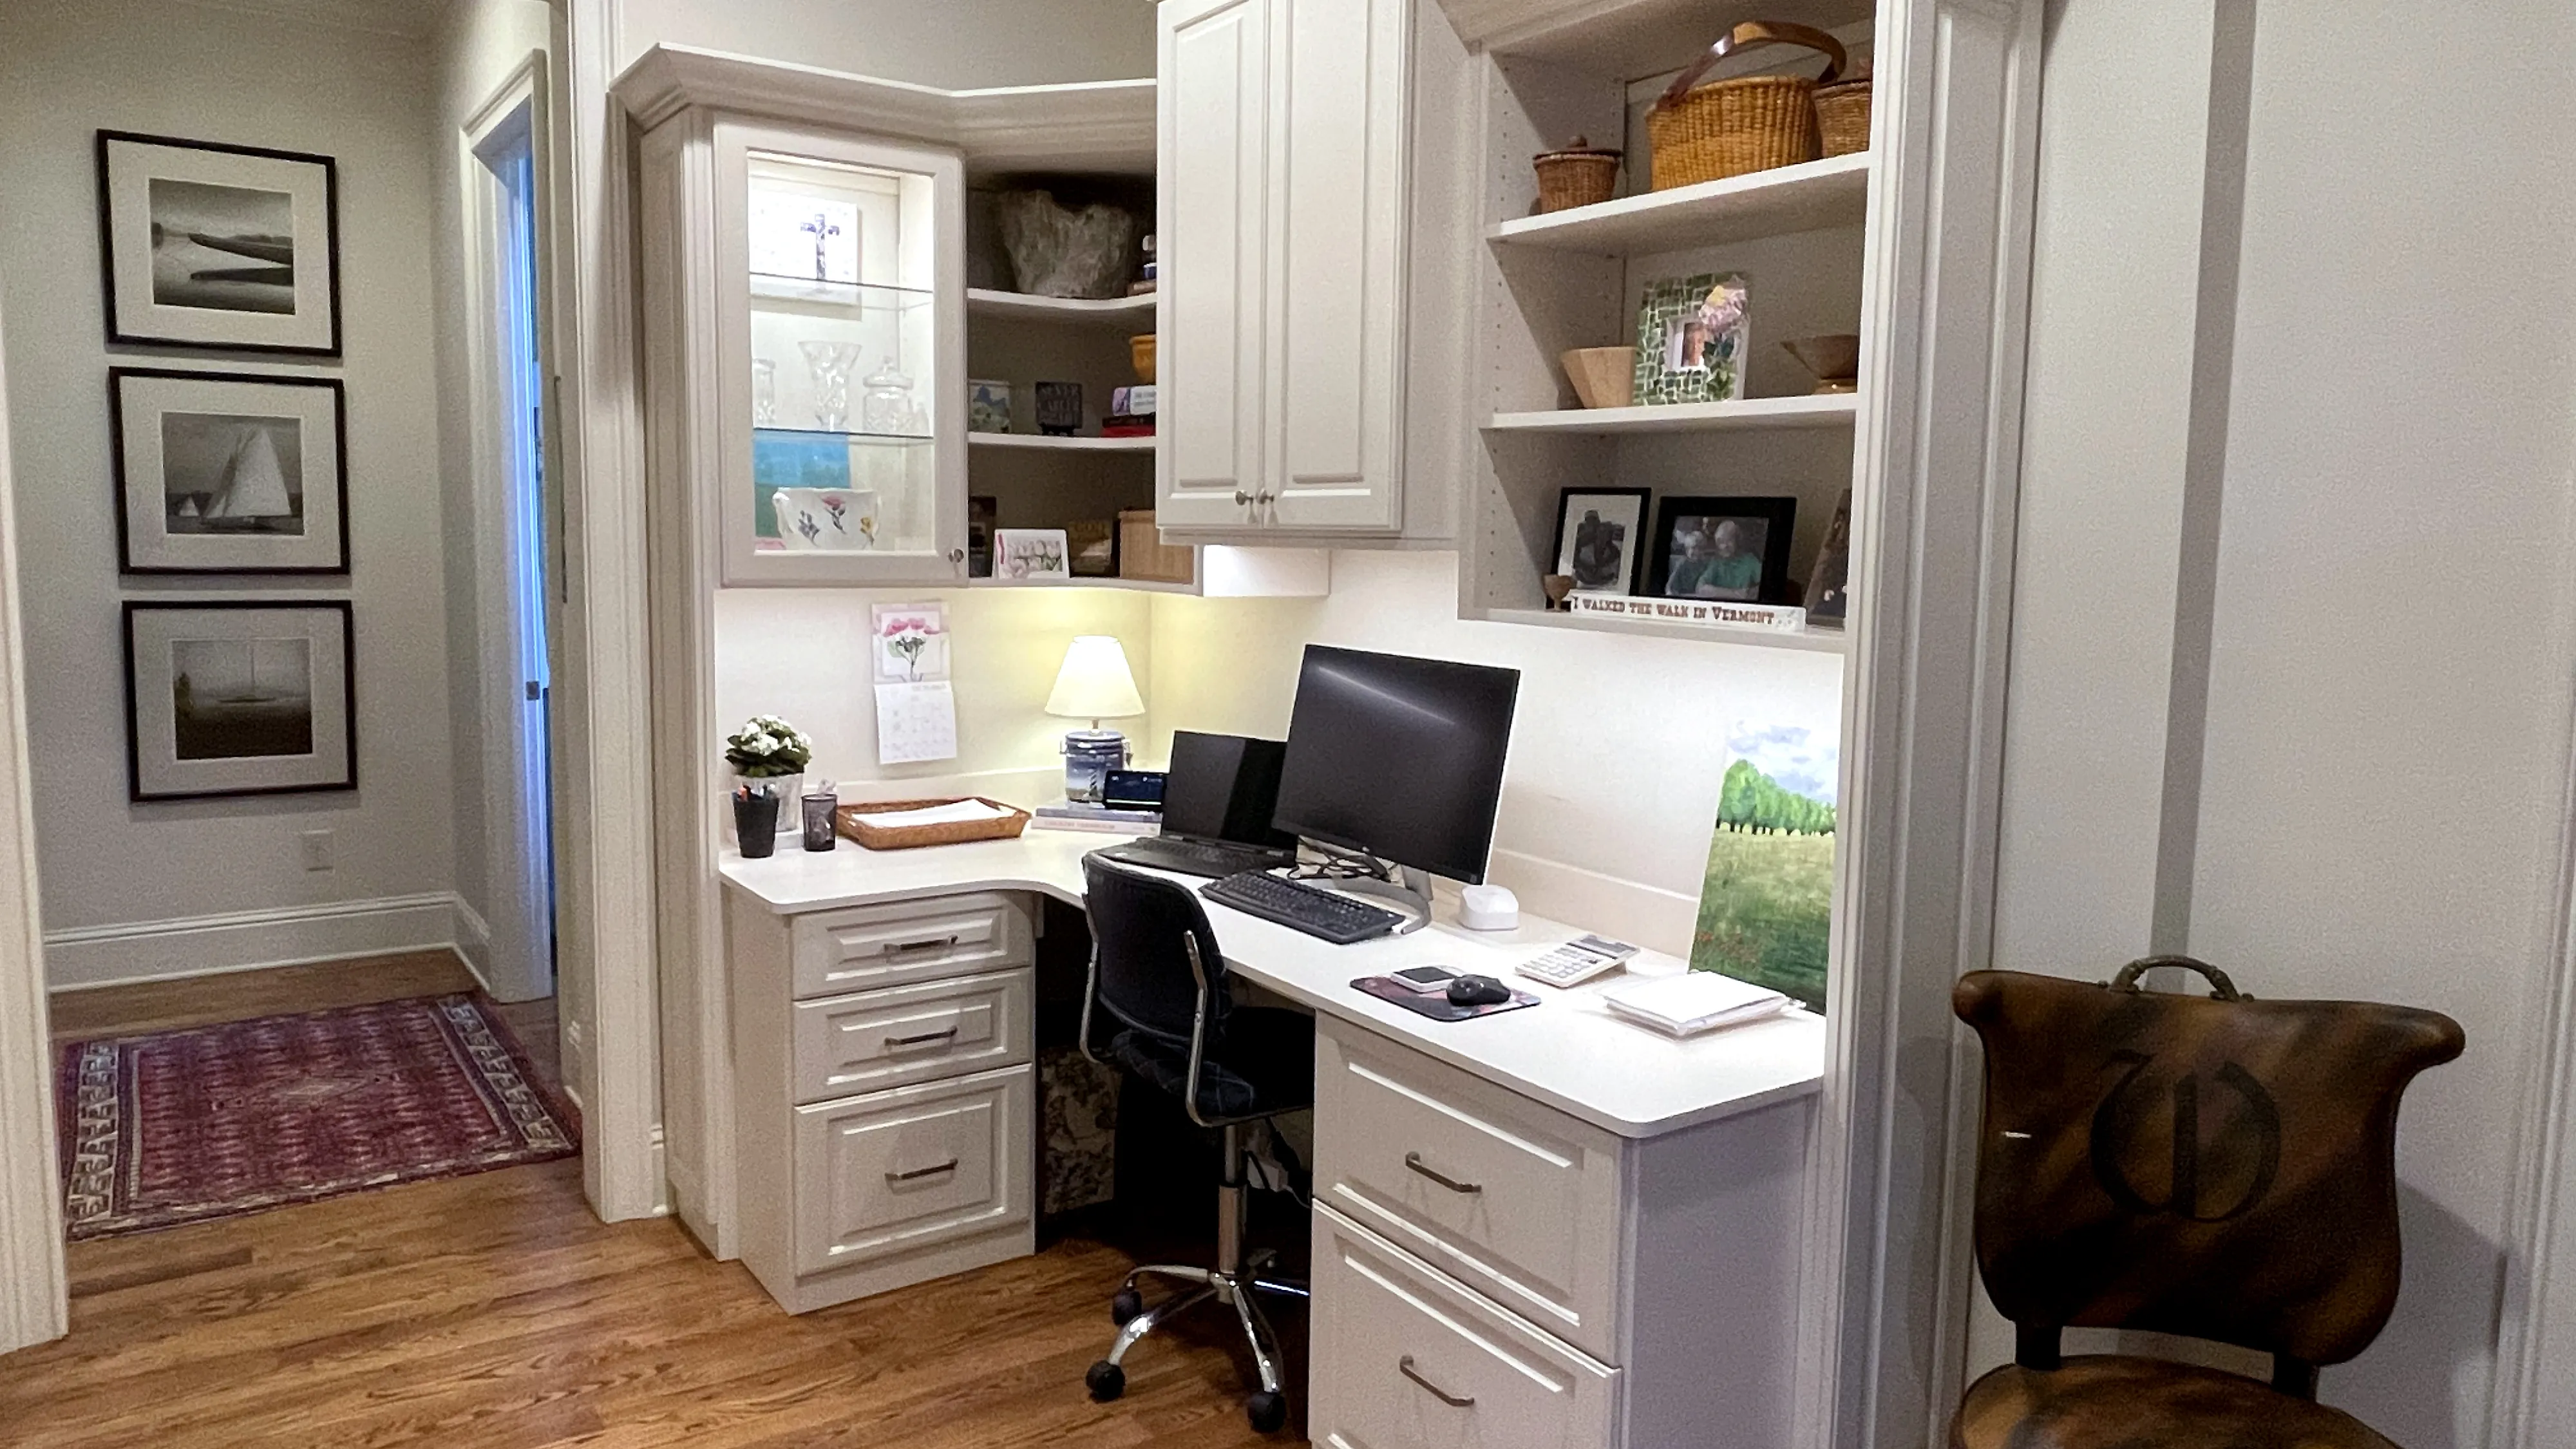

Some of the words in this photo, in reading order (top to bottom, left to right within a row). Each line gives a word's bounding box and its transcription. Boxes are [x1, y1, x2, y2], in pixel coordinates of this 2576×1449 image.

[1573, 596, 1578, 609] I
[1583, 599, 1625, 612] WALKED
[1629, 602, 1652, 615] THE
[1656, 604, 1688, 618] WALK
[1694, 607, 1707, 618] IN
